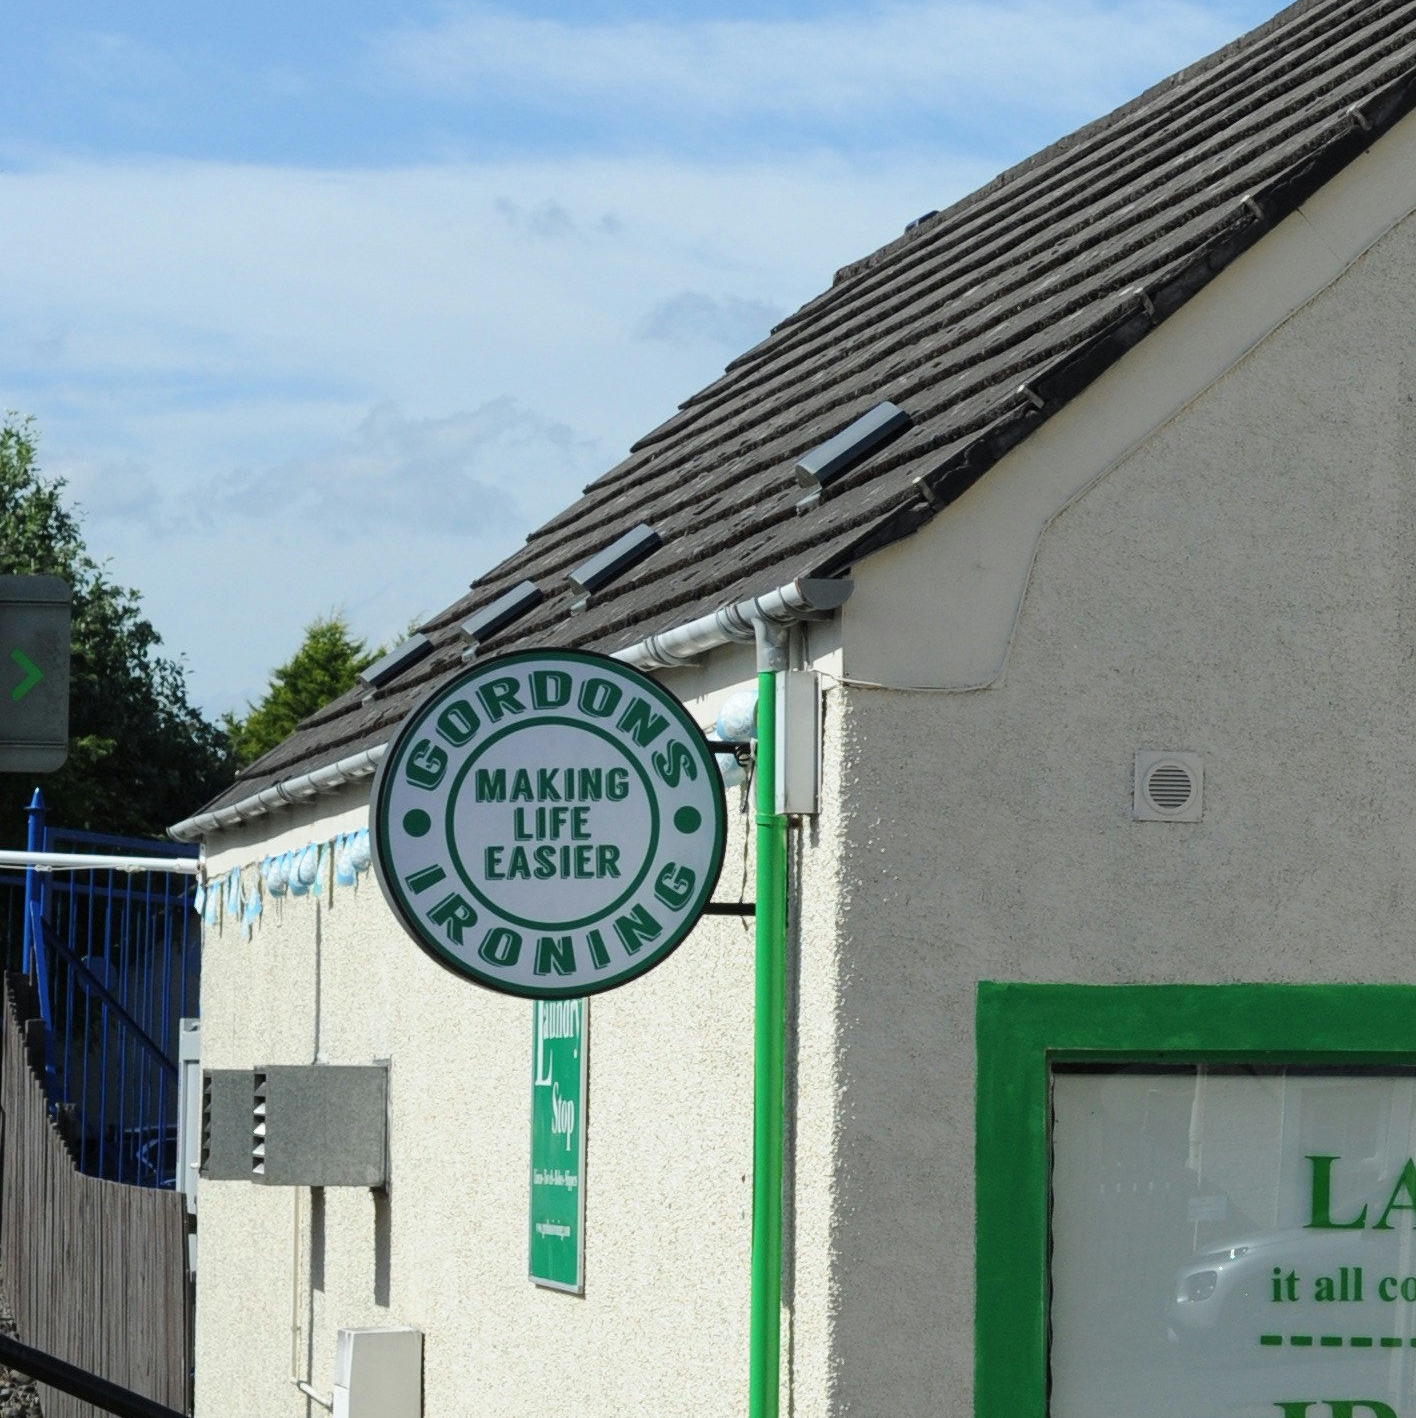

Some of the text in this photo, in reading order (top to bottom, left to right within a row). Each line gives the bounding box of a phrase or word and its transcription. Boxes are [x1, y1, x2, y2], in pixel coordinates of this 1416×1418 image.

[405, 670, 699, 791] GORDONS
[475, 766, 630, 802] MAKING
[512, 806, 592, 841] LIFE
[484, 844, 621, 880] EASIER
[405, 862, 697, 976] IRONING
[551, 1082, 575, 1151] Stop
[1269, 1264, 1302, 1306] it
[1311, 1264, 1366, 1305] all
